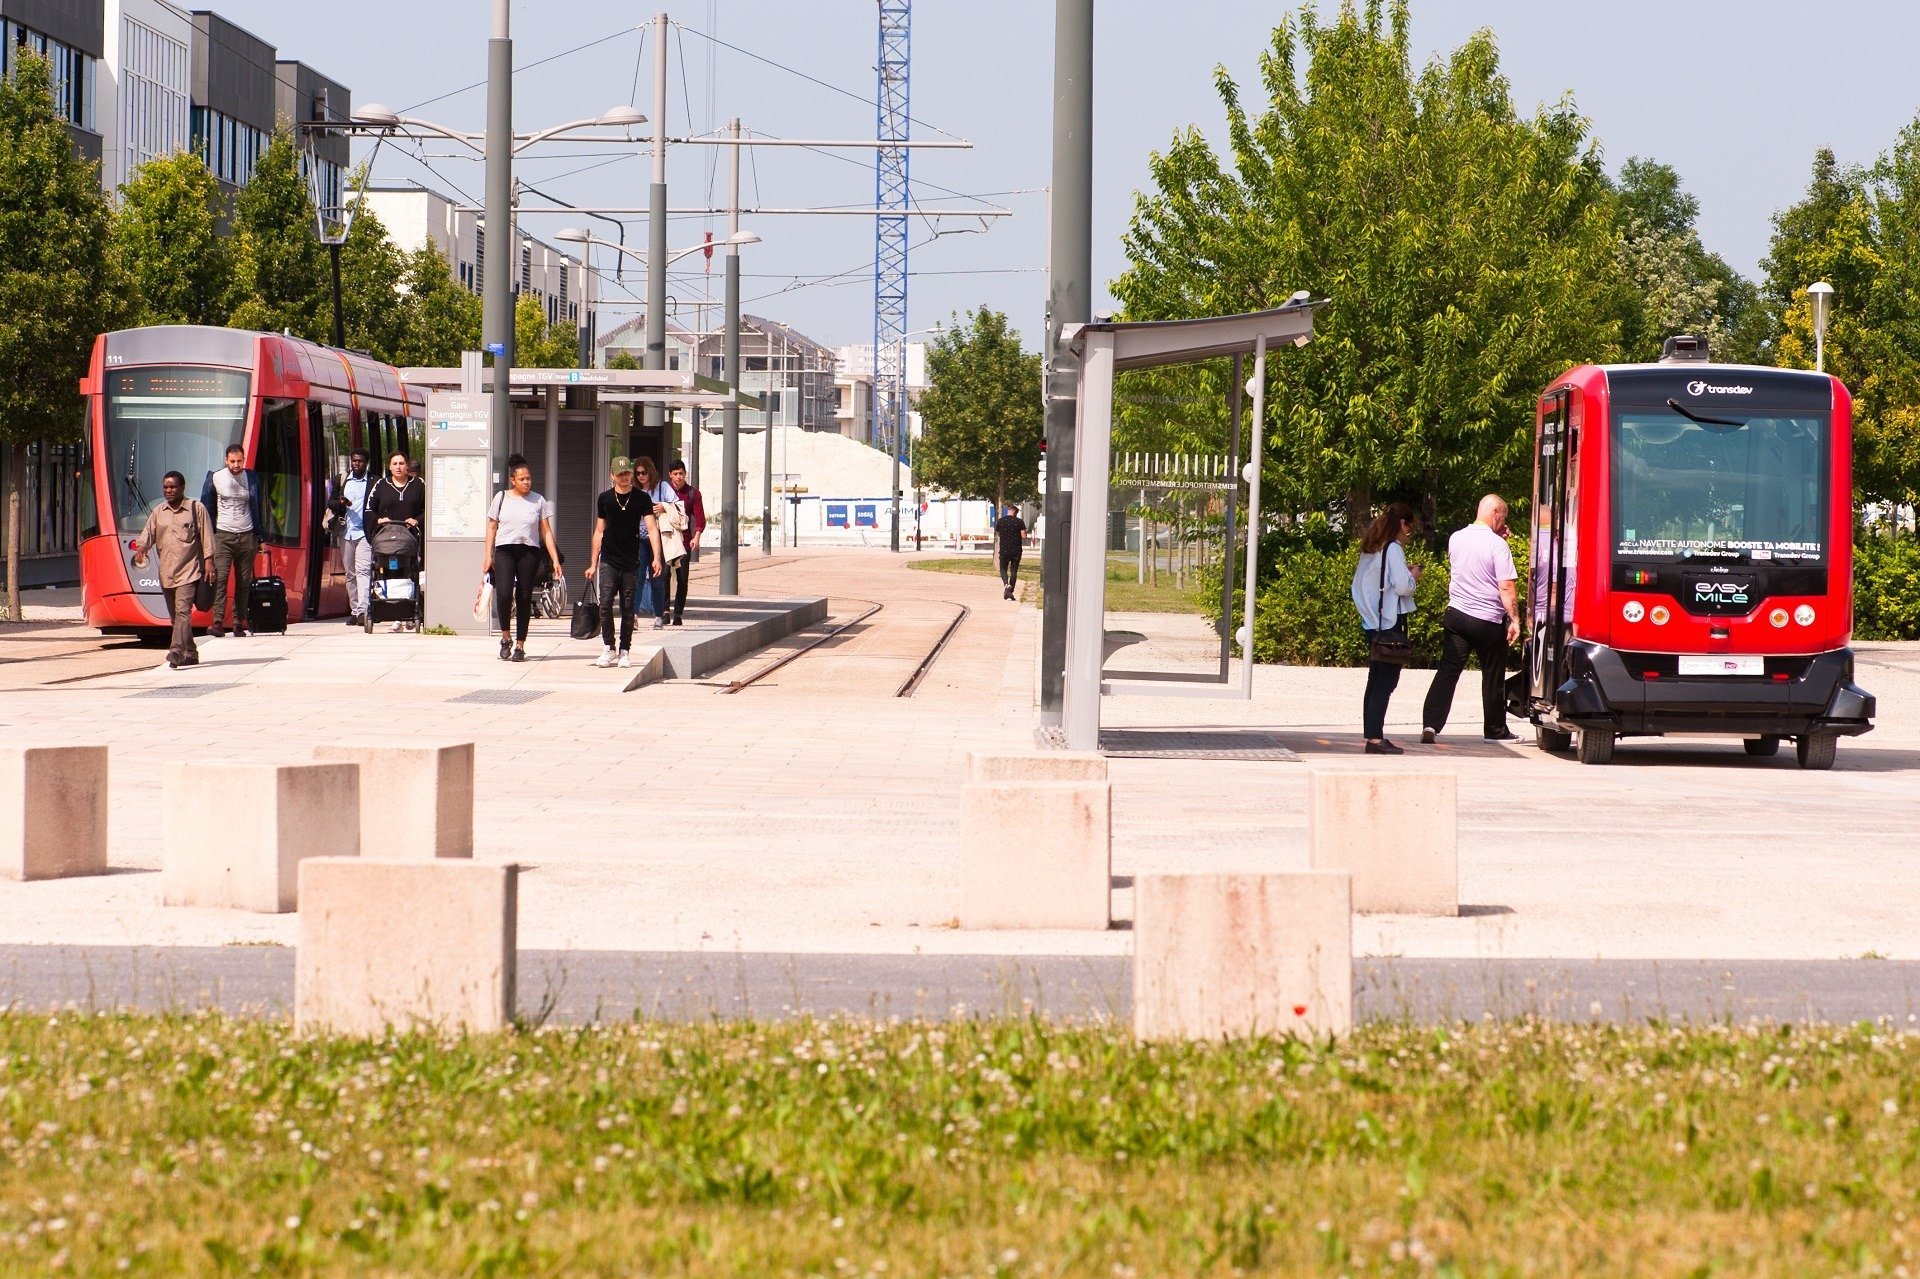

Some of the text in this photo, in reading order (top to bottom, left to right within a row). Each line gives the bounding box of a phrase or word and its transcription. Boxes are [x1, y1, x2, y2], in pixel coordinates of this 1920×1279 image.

[107, 355, 123, 364] 111
[1706, 385, 1753, 395] transdev
[451, 401, 468, 410] Gare
[430, 410, 489, 420] Champagne TGV
[1639, 539, 1677, 548] NAVETTE
[1677, 540, 1727, 549] AUTONOME
[1727, 541, 1763, 550] BOOSTE
[1763, 542, 1775, 550] TA
[1775, 542, 1816, 551] MOBILITE
[1617, 548, 1674, 556] www.transdev.com
[1693, 549, 1721, 557] Transdev
[1721, 550, 1740, 558] Group
[1801, 552, 1821, 560] Group
